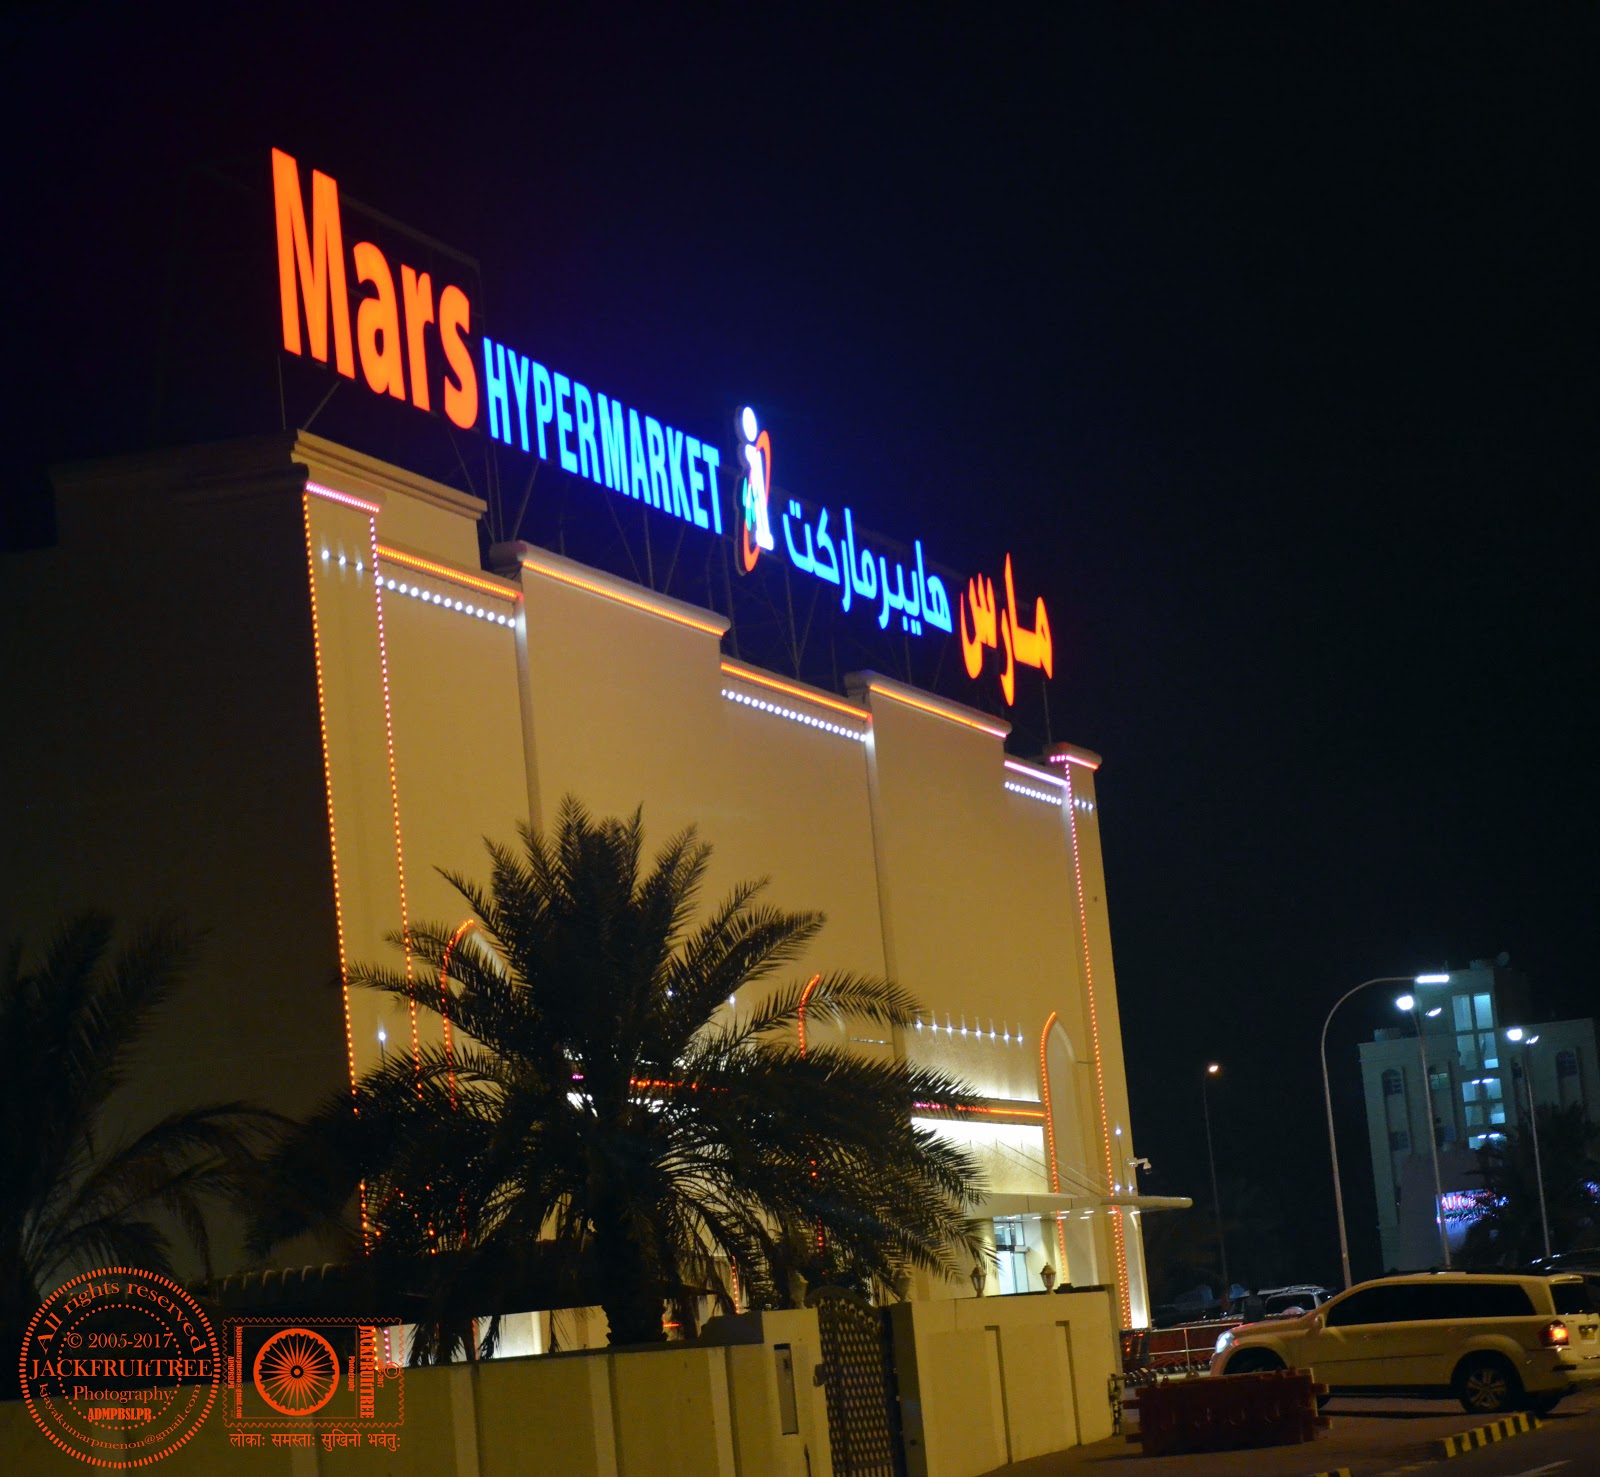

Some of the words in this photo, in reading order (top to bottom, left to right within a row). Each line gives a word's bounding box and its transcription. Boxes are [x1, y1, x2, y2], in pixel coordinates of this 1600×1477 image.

[271, 146, 479, 430] Mars
[483, 336, 723, 535] HYPERMARKET
[782, 499, 952, 636] هايبرماركت
[960, 552, 1053, 706] مارس
